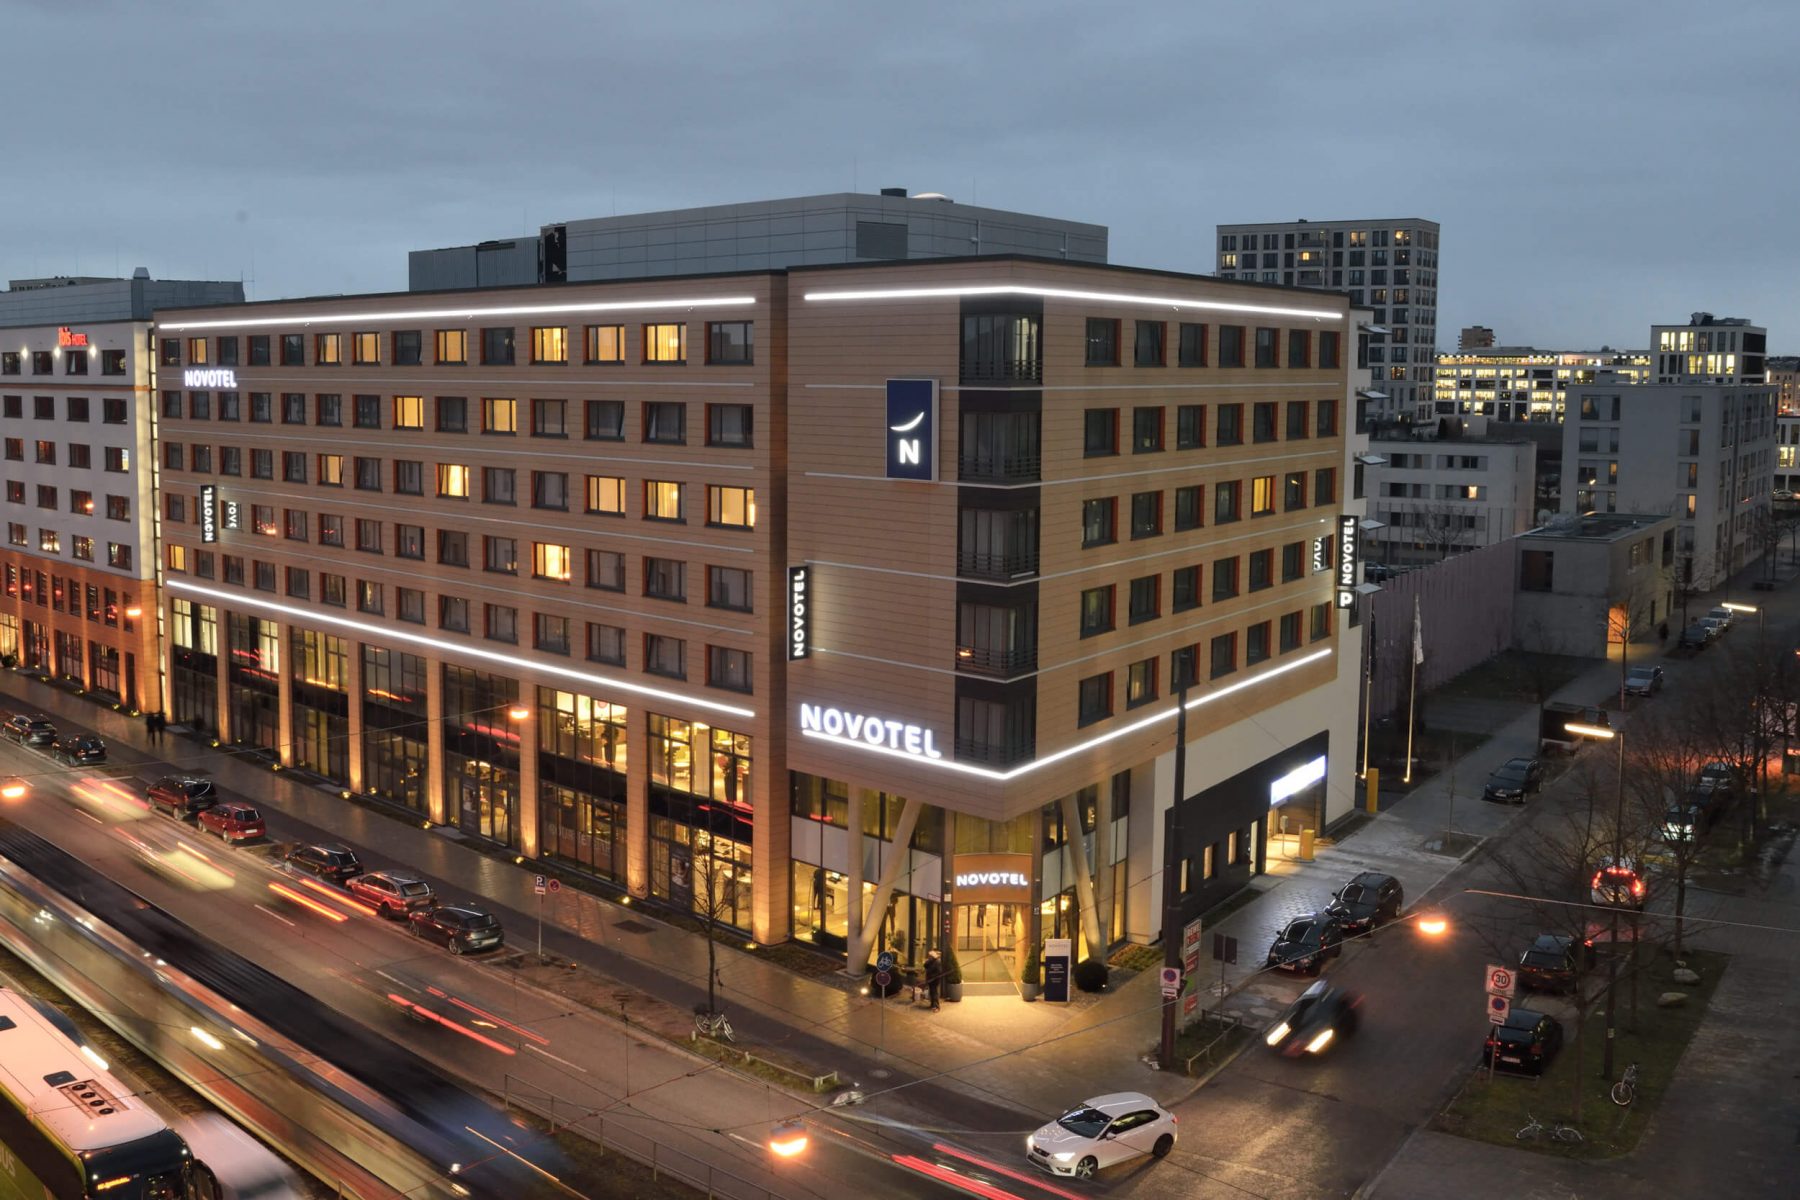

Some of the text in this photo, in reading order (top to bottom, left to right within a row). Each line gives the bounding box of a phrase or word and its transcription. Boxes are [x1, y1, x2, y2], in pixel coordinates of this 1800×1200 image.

[184, 369, 237, 388] NOVOTEL
[899, 438, 919, 464] N
[203, 487, 213, 541] NOVOTEL
[1342, 518, 1354, 584] NOVOTEL
[794, 570, 805, 656] NOVOTEL
[1340, 592, 1353, 607] P
[801, 703, 941, 759] NOVOTEL
[956, 872, 1028, 887] NOVOTEL
[1495, 973, 1507, 984] 30
[0, 1145, 16, 1177] US
